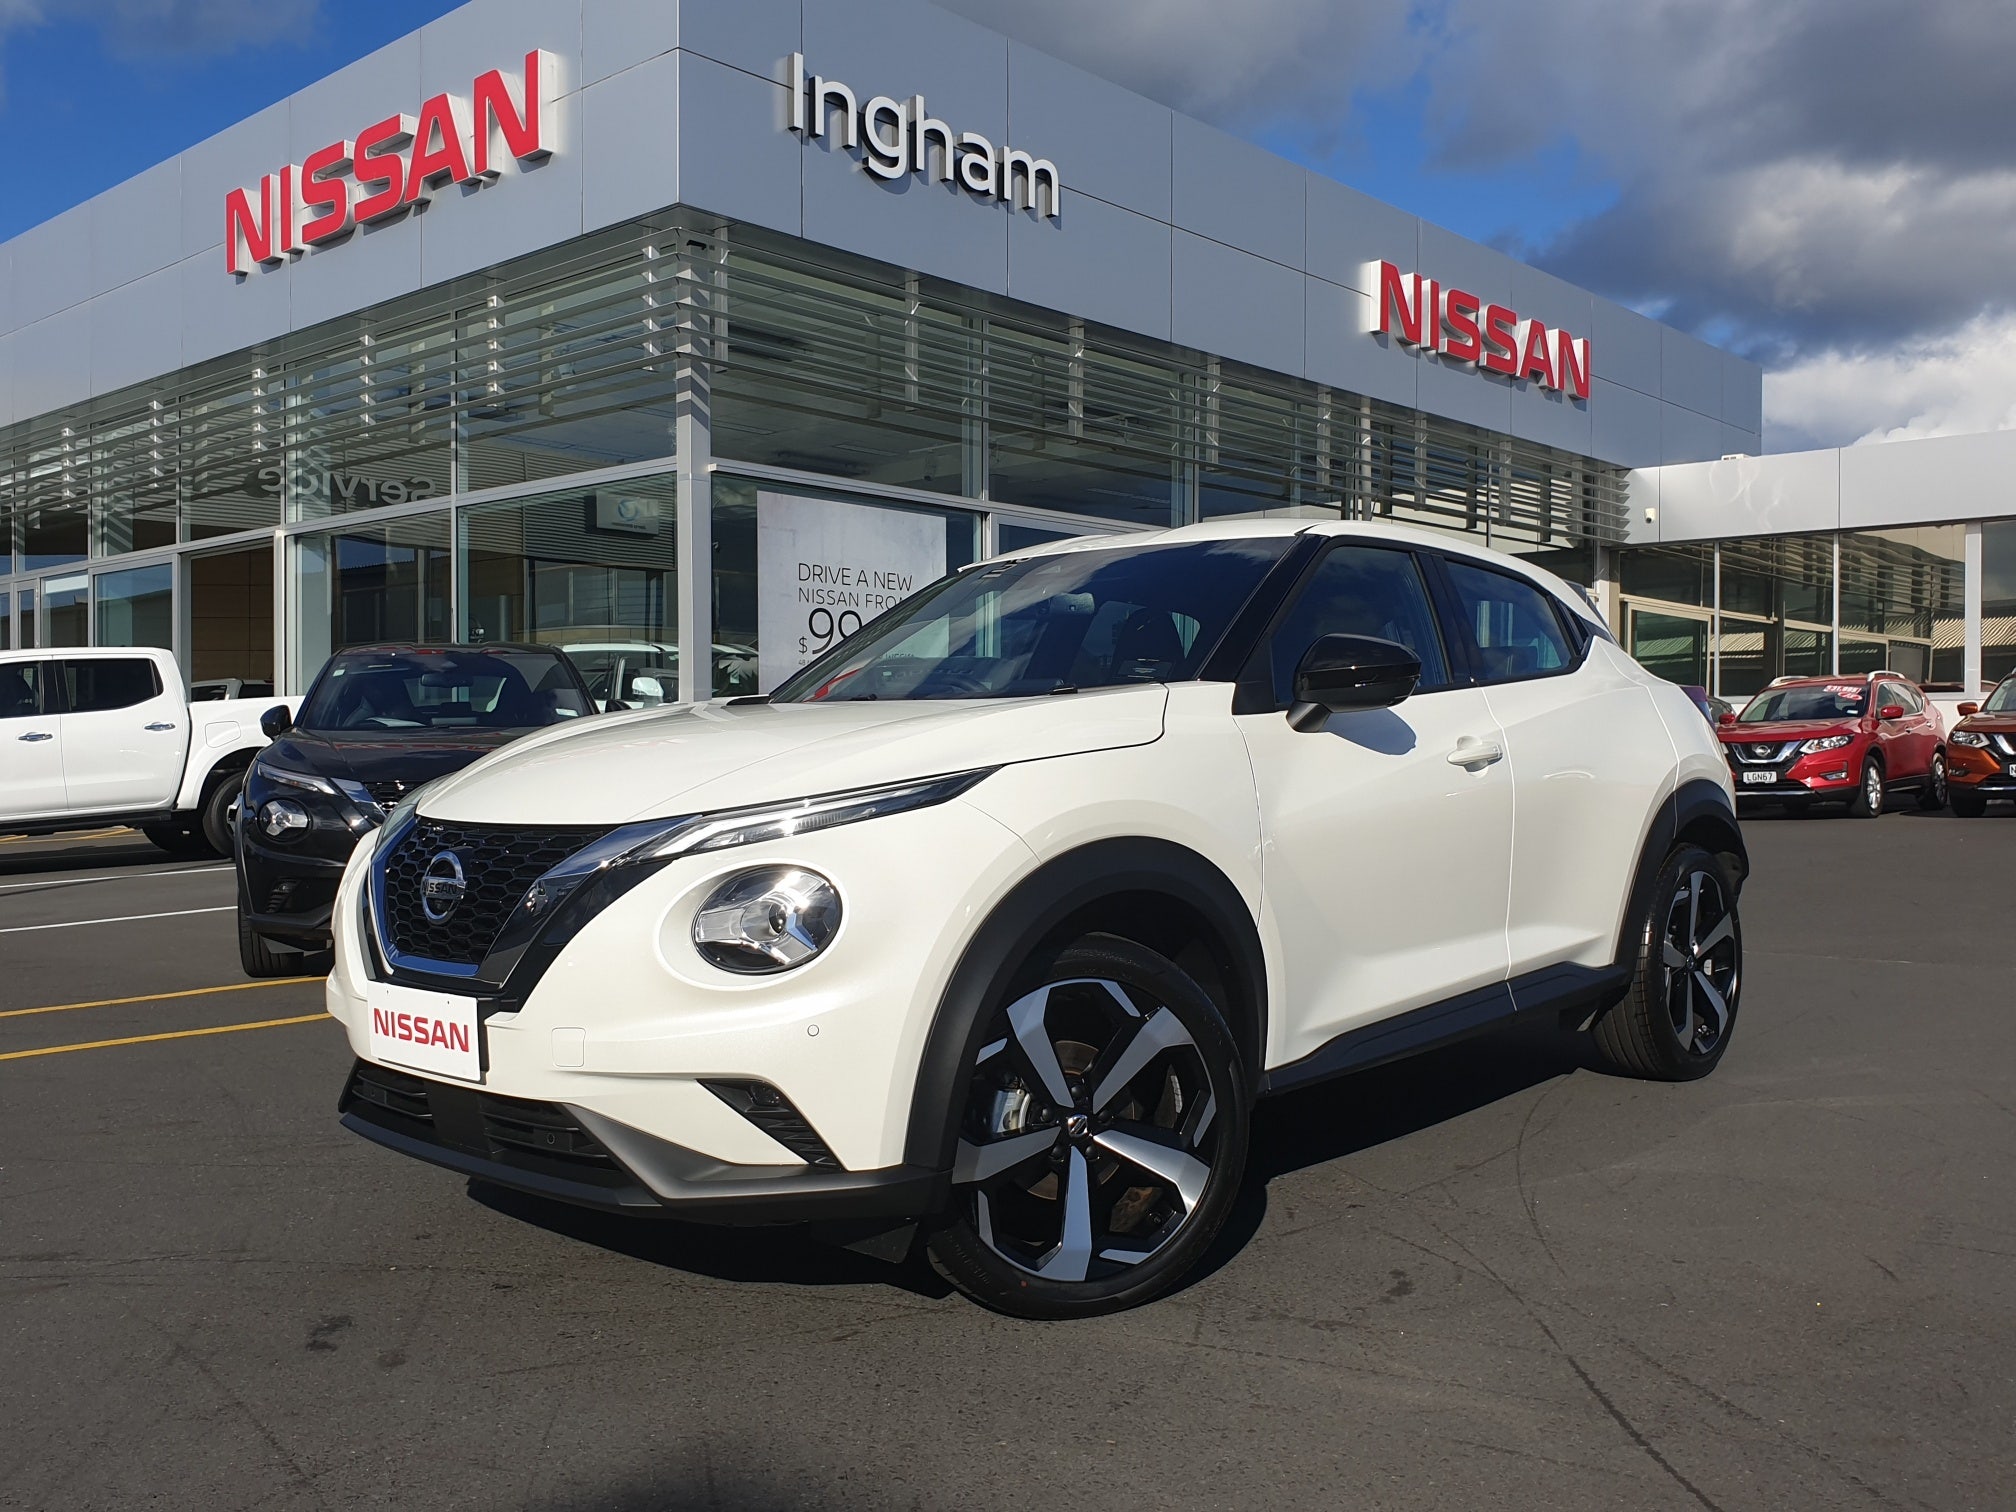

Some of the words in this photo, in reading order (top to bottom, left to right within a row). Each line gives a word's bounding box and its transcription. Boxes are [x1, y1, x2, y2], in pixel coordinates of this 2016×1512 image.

[226, 49, 548, 276] NISSAN
[788, 52, 1060, 217] Ingham
[1373, 259, 1590, 399] NISSAN
[798, 563, 851, 586] DRIVE
[856, 570, 869, 587] A
[874, 571, 912, 592] NEW
[798, 587, 859, 608] NISSAN
[865, 594, 904, 610] FRO
[373, 1007, 470, 1053] NISSAN
